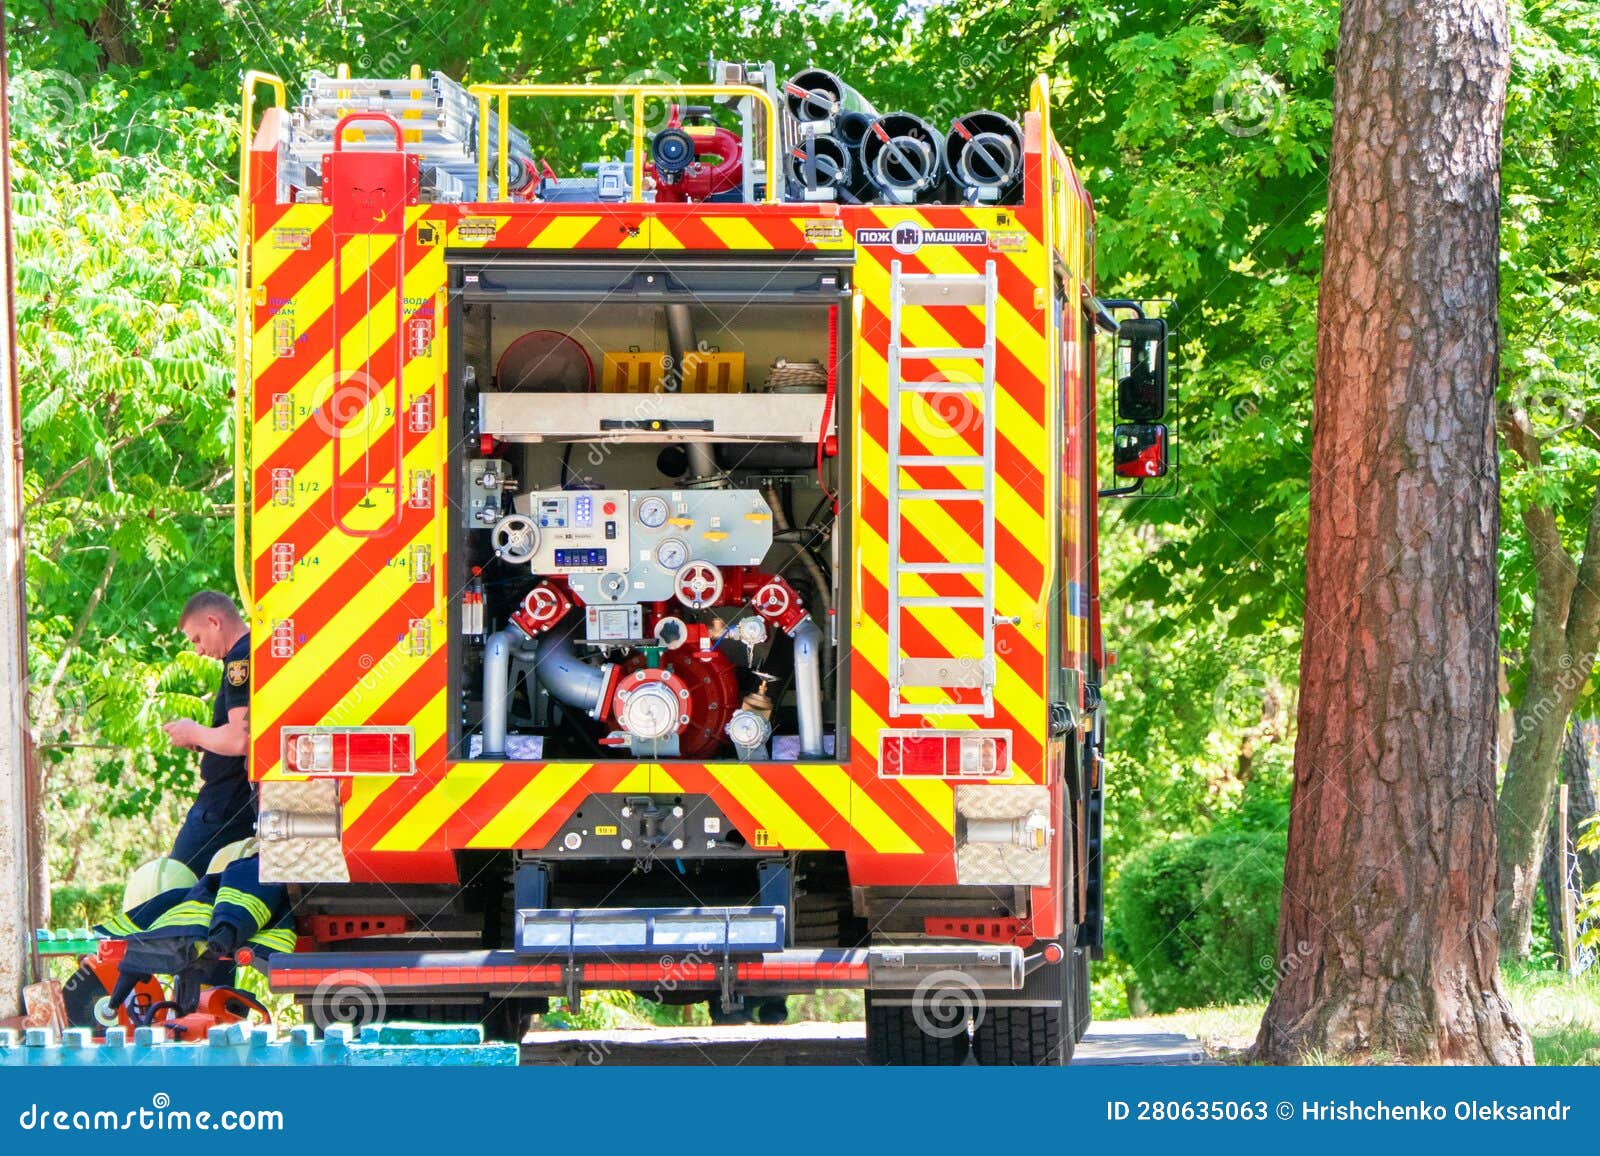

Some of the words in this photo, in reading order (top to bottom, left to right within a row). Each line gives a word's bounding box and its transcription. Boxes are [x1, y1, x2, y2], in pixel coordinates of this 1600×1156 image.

[860, 231, 890, 242] ПОЖ
[925, 231, 983, 243] МАШИНА
[299, 482, 319, 492] 1/2
[300, 556, 319, 566] 1/4
[386, 557, 406, 568] 1/4
